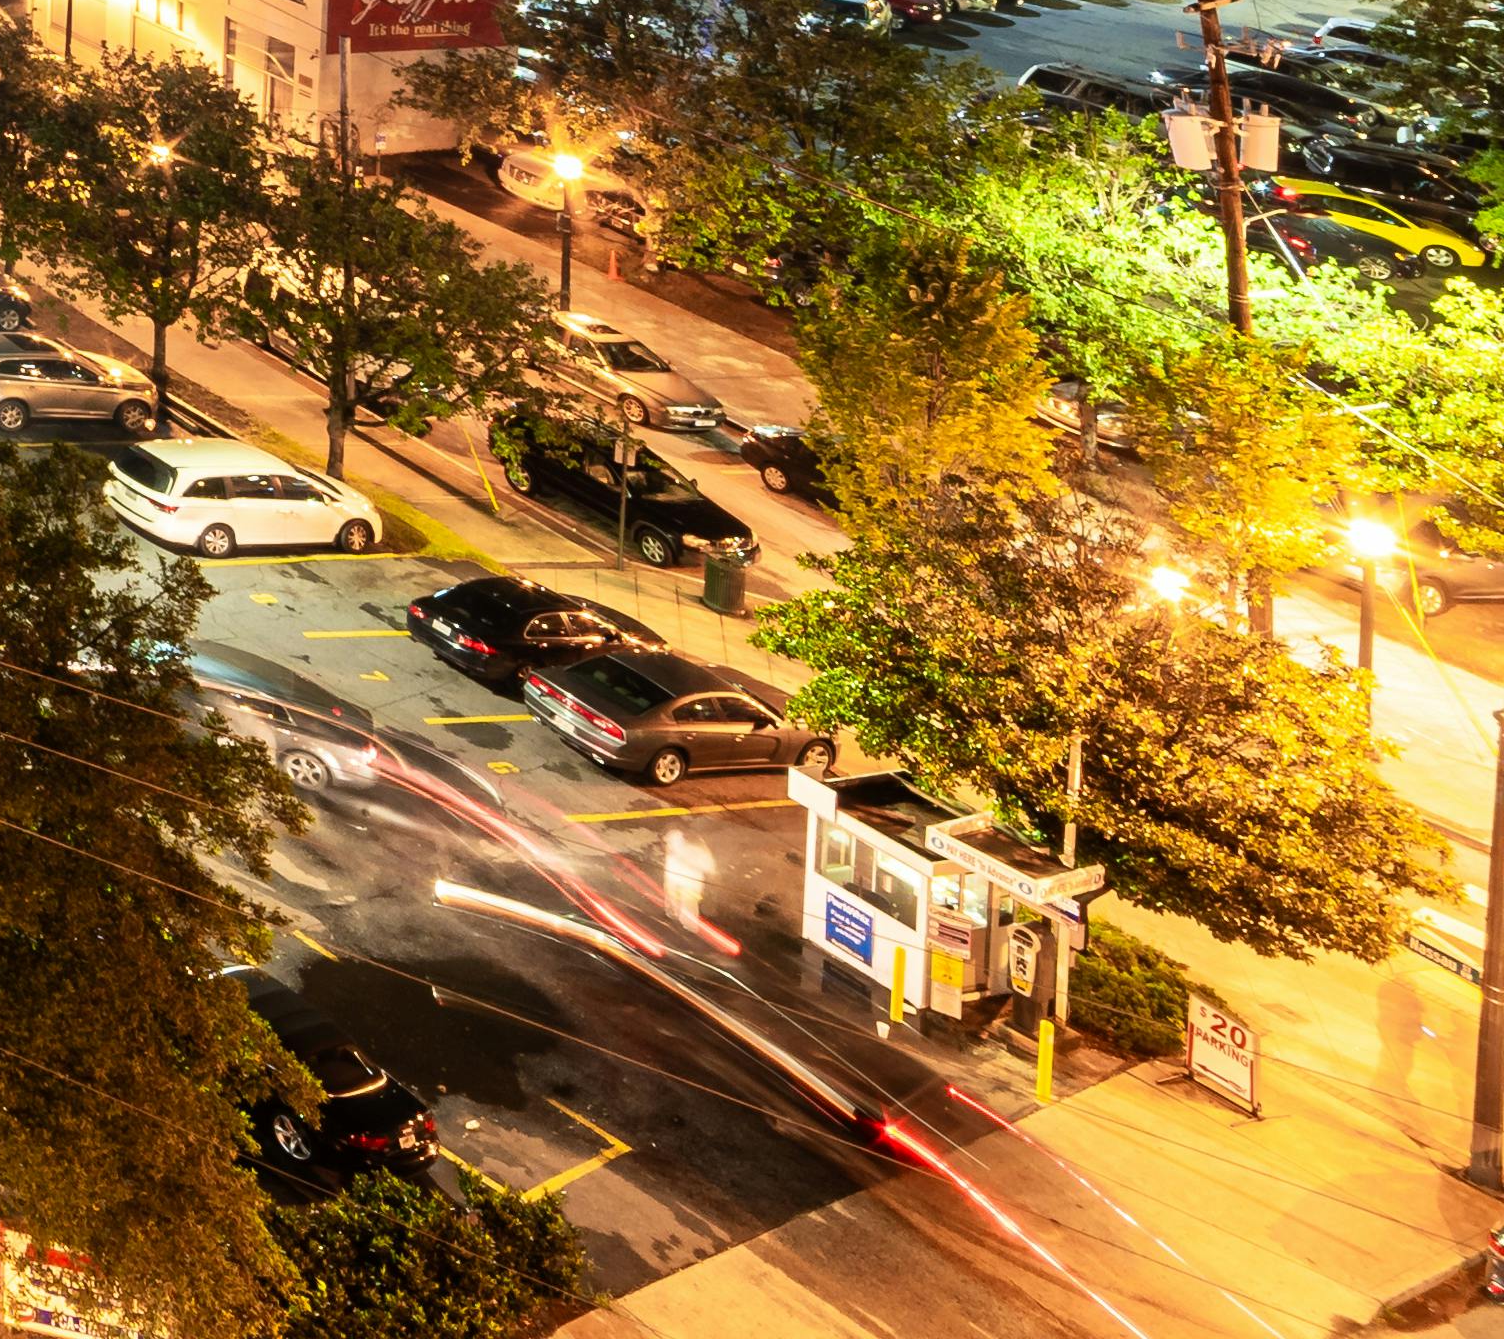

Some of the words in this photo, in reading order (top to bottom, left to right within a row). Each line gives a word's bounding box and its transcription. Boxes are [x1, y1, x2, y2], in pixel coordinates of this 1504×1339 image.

[369, 23, 387, 36] It's
[391, 23, 410, 35] the
[414, 22, 437, 34] real
[1194, 1026, 1249, 1068] PARKING
[1210, 1013, 1247, 1050] 20
